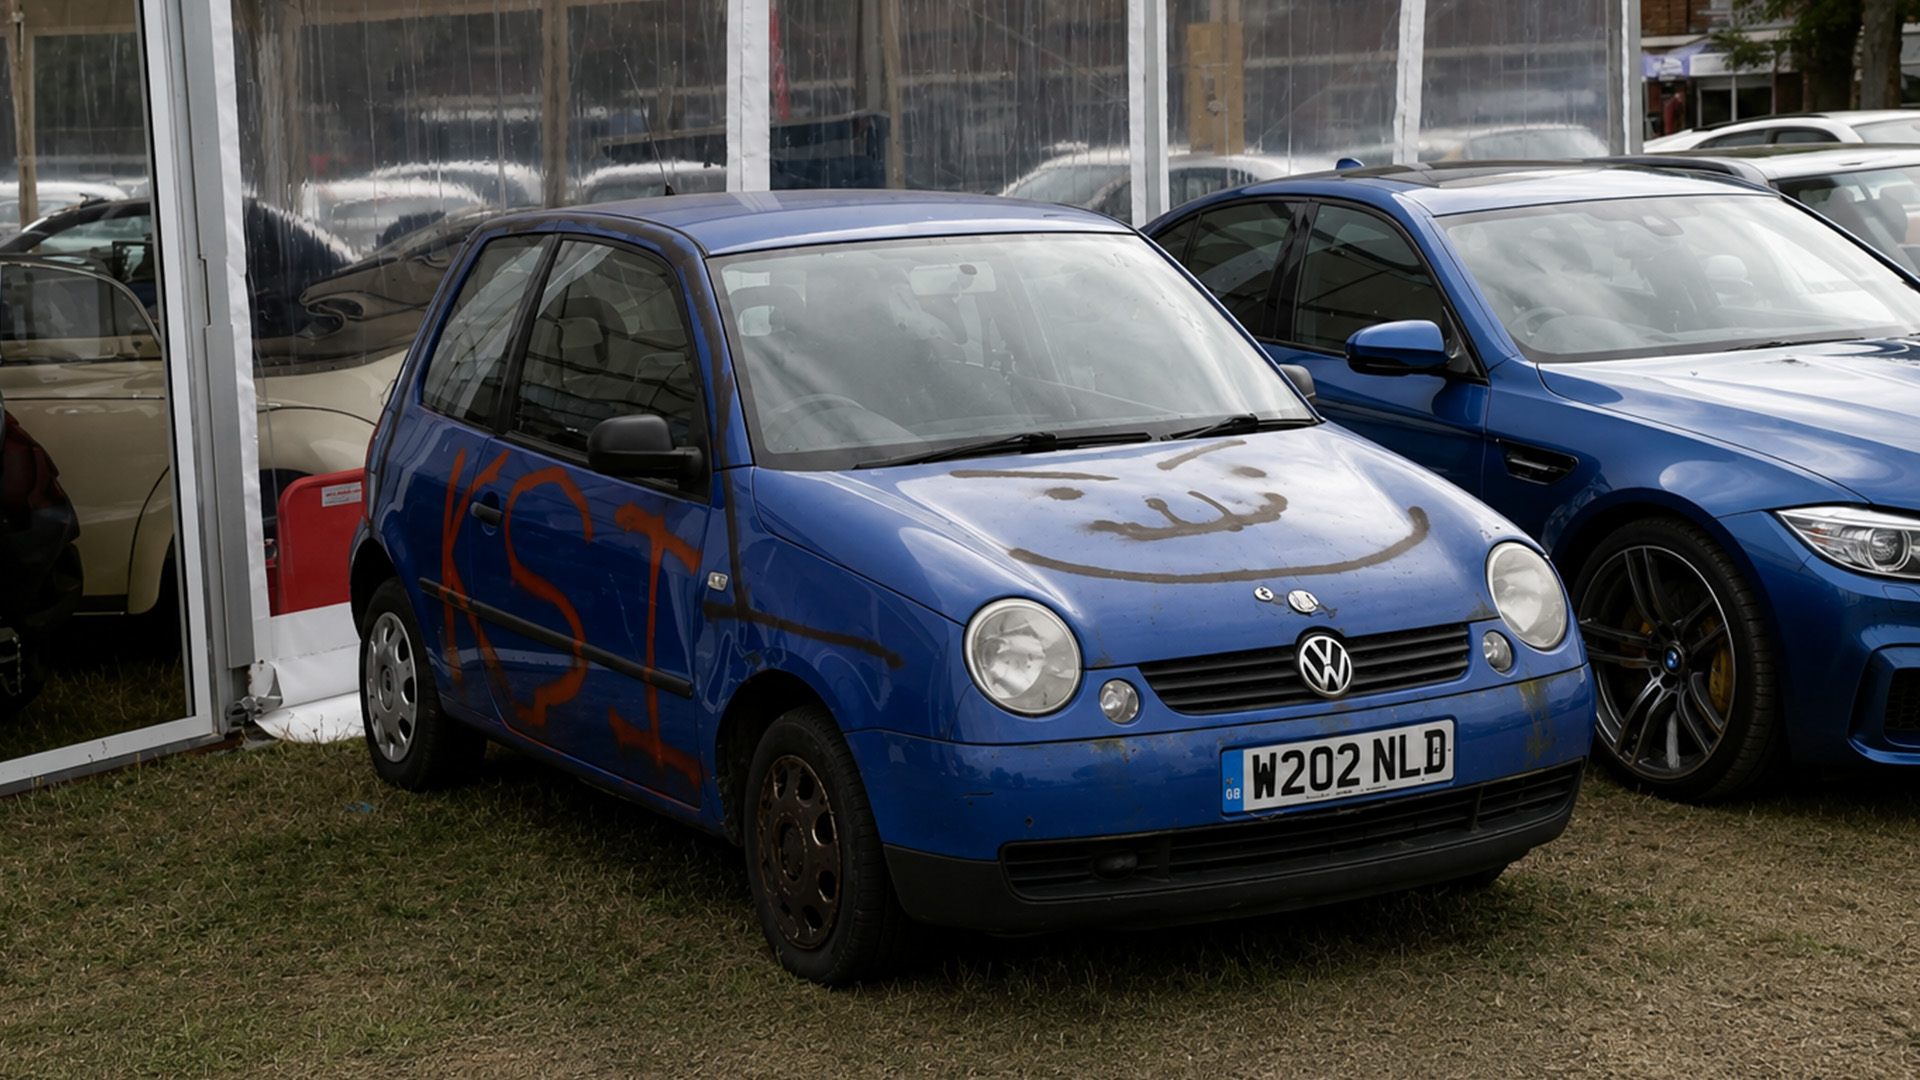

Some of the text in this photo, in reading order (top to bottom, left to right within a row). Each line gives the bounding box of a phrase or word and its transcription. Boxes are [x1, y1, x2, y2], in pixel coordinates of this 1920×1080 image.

[441, 446, 710, 790] KSI
[1252, 728, 1447, 800] W202 NLD
